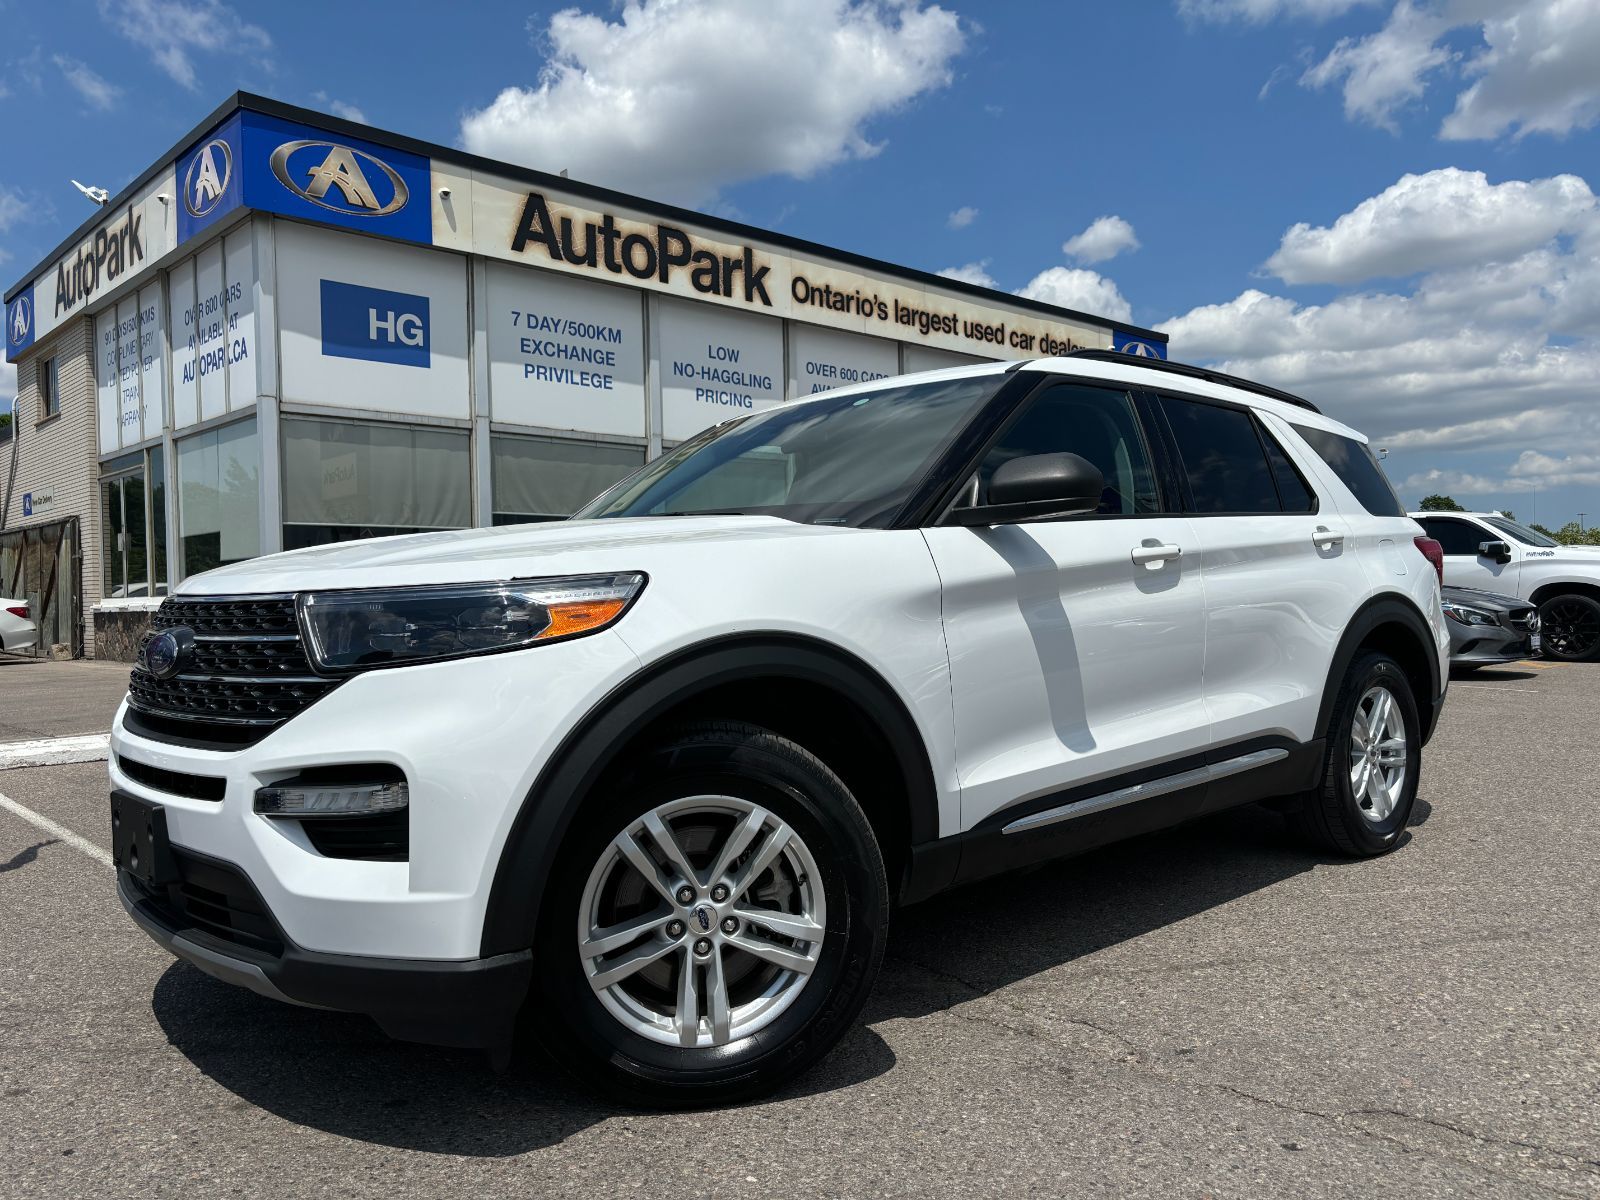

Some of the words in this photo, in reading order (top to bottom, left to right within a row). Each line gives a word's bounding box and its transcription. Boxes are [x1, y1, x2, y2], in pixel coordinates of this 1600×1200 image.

[54, 203, 143, 318] AutoPark
[511, 192, 772, 306] AutoPark
[184, 304, 204, 326] OVR
[205, 295, 218, 316] 600
[229, 312, 239, 332] AT
[791, 276, 888, 320] Ontario's
[894, 299, 959, 335] largest
[963, 321, 1004, 345] used
[1009, 329, 1034, 351] car
[1039, 333, 1086, 356] deal
[368, 308, 424, 347] HG
[511, 311, 521, 327] 7
[526, 313, 622, 344] DAY/500KM
[183, 337, 248, 384] AUOPAR.CA
[520, 337, 616, 367] EXCHANGE
[708, 345, 739, 363] LOW
[524, 363, 613, 390] PRIVILEGE
[673, 361, 772, 391] NO-HAGGLING
[806, 361, 837, 379] OVER
[840, 367, 859, 382] 600
[861, 371, 890, 382] CAR
[695, 388, 753, 408] PRICING
